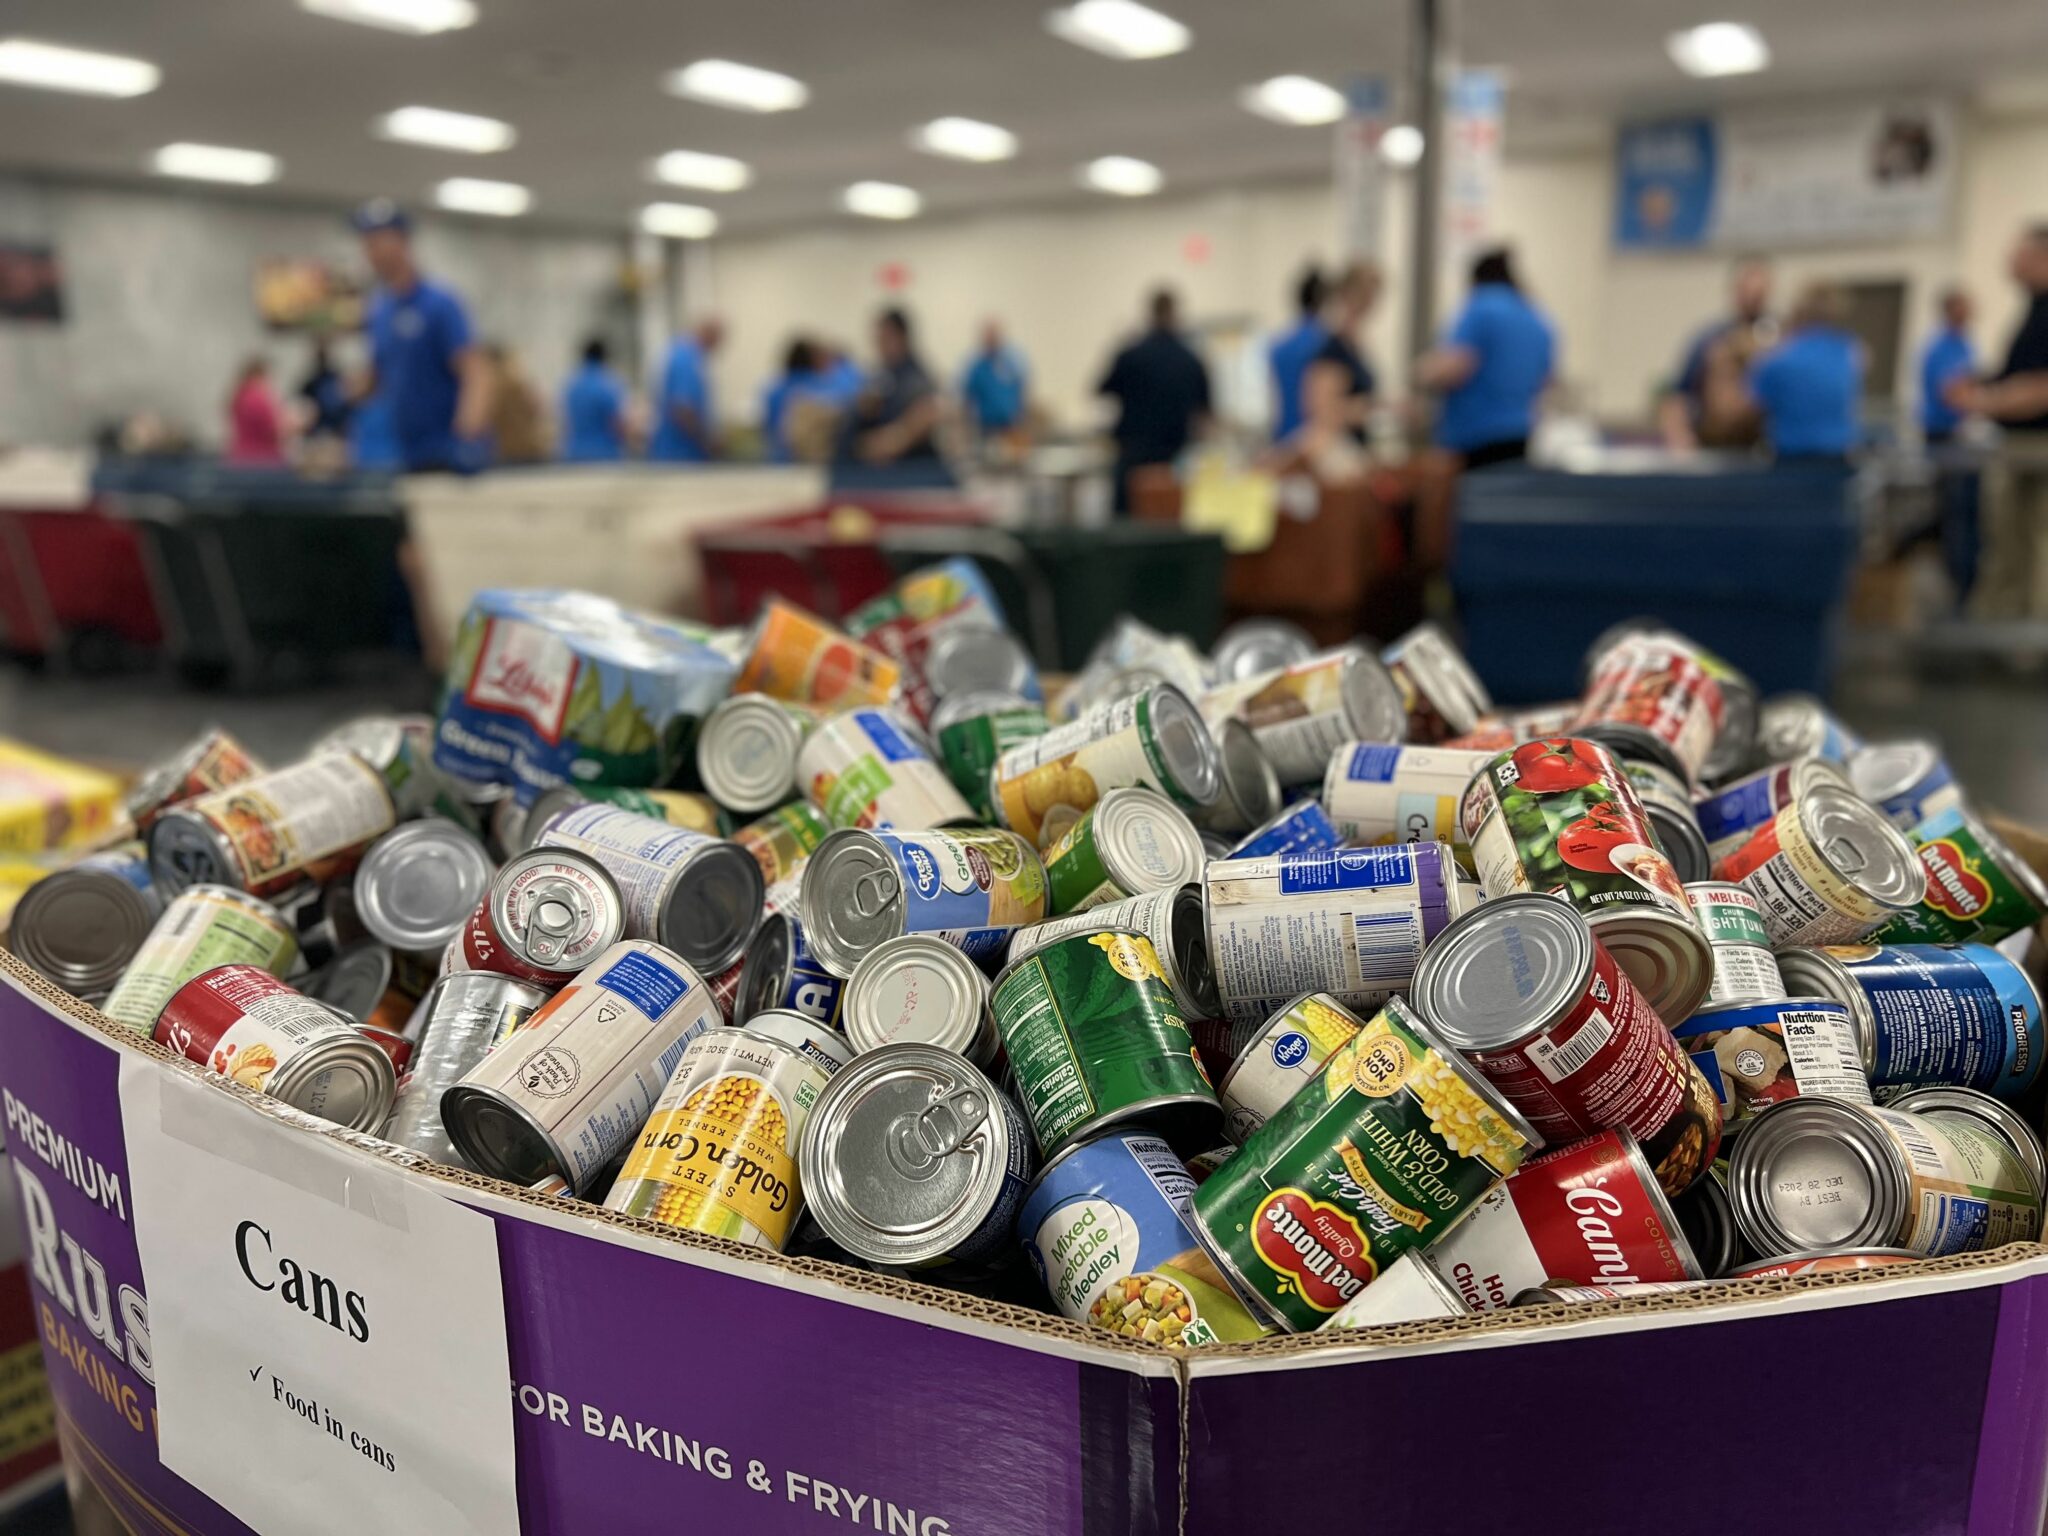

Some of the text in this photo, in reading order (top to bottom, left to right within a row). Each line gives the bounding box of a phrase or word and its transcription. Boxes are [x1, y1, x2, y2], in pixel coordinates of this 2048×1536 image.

[908, 850, 930, 890] Great
[918, 850, 934, 881] Value
[1778, 855, 1829, 912] Nutrition Facts
[1921, 845, 1980, 913] Del Monte
[1590, 894, 1601, 904] NET
[1601, 893, 1614, 902] WT
[1688, 892, 1741, 904] BMBLE
[1771, 898, 1806, 929] 180 320
[1782, 1013, 1826, 1024] Nutrition
[1786, 1025, 1815, 1035] Facts
[1909, 990, 1929, 1050] LISTA PARA SERVIR
[1941, 988, 1962, 1040] READY TO SERVE
[737, 1050, 755, 1062] WT
[1277, 1038, 1304, 1062] Kroger
[1373, 1049, 1395, 1073] GMO
[2011, 1010, 2028, 1072] PROGRESSO
[537, 1057, 561, 1084] Peak of
[542, 1051, 573, 1084] Freshness
[755, 1054, 775, 1069] NET
[1363, 1058, 1387, 1082] NON
[795, 1094, 811, 1109] non
[800, 1088, 816, 1100] BPA
[1027, 1064, 1075, 1113] Calories 70
[1379, 1083, 1390, 1091] NO
[1050, 1101, 1088, 1131] Nutrition
[2, 1087, 127, 1220] PREMIUM
[644, 1132, 699, 1161] Corn
[679, 1117, 775, 1164] WHOLE KERNEL
[1356, 1109, 1460, 1211] GOLD & WHITE
[1401, 1128, 1449, 1174] CORN
[672, 1165, 736, 1198] SWEET
[706, 1142, 789, 1212] Golden
[1351, 1159, 1416, 1222] HARVEST SELECTS
[1778, 1176, 1843, 1191] DEC 28 2024
[1326, 1168, 1402, 1234] Fresh Cut
[1800, 1191, 1840, 1207] BEST BY
[1051, 1207, 1097, 1263] Mixed
[1265, 1203, 1364, 1300] Del Monte
[1314, 1216, 1355, 1257] Quality
[235, 1220, 370, 1343] Cans
[1054, 1227, 1108, 1306] Vegetable
[1070, 1245, 1120, 1310] Medley
[42, 1302, 143, 1433] BAKING
[273, 1375, 396, 1473] Food in cans
[582, 1403, 732, 1481] BAKING
[746, 1460, 772, 1495] &
